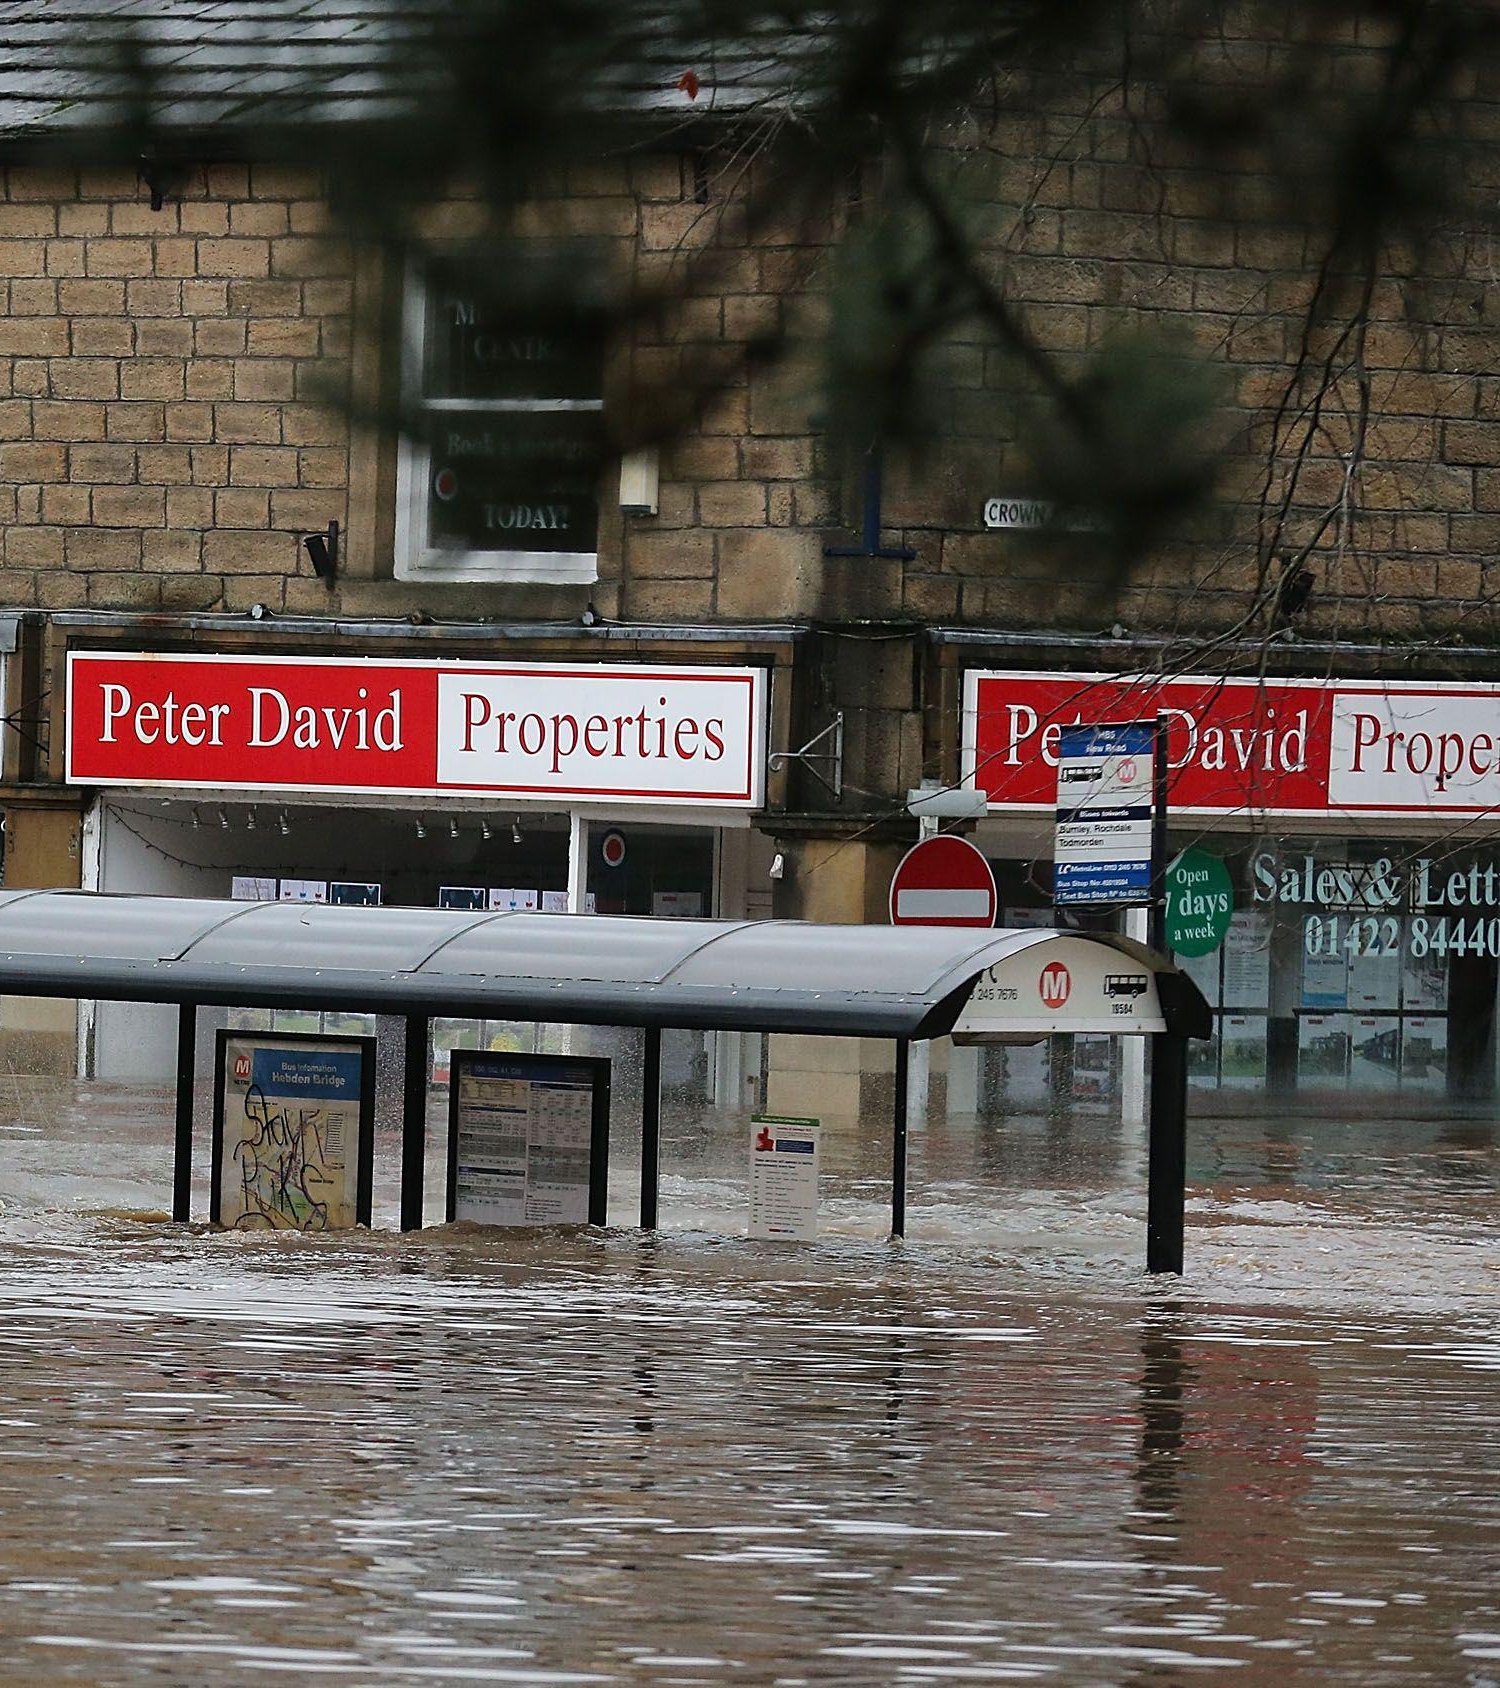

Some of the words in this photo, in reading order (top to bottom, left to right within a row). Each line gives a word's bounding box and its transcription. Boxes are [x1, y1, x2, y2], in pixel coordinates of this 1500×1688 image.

[988, 503, 1045, 523] CROWN
[98, 683, 230, 747] Peter
[246, 688, 404, 752] David
[459, 693, 725, 773] Properties
[1156, 707, 1307, 773] David
[1059, 826, 1092, 835] Burnley,
[1094, 823, 1132, 832] Rochdale
[1059, 838, 1104, 847] Todmorden
[1176, 868, 1209, 887] Open
[1253, 853, 1354, 905] Sales
[1365, 857, 1401, 906] &
[1416, 858, 1500, 906] Lett
[1179, 889, 1229, 921] days
[1174, 929, 1181, 941] a
[1184, 922, 1216, 939] week
[1305, 915, 1399, 958] 01422
[978, 988, 994, 1000] 245
[997, 988, 1018, 1000] 7676
[1043, 971, 1069, 1000] M
[236, 1060, 250, 1073] M
[281, 1062, 297, 1071] Bus
[272, 1072, 310, 1084] Hebden
[312, 1075, 346, 1088] Bridge
